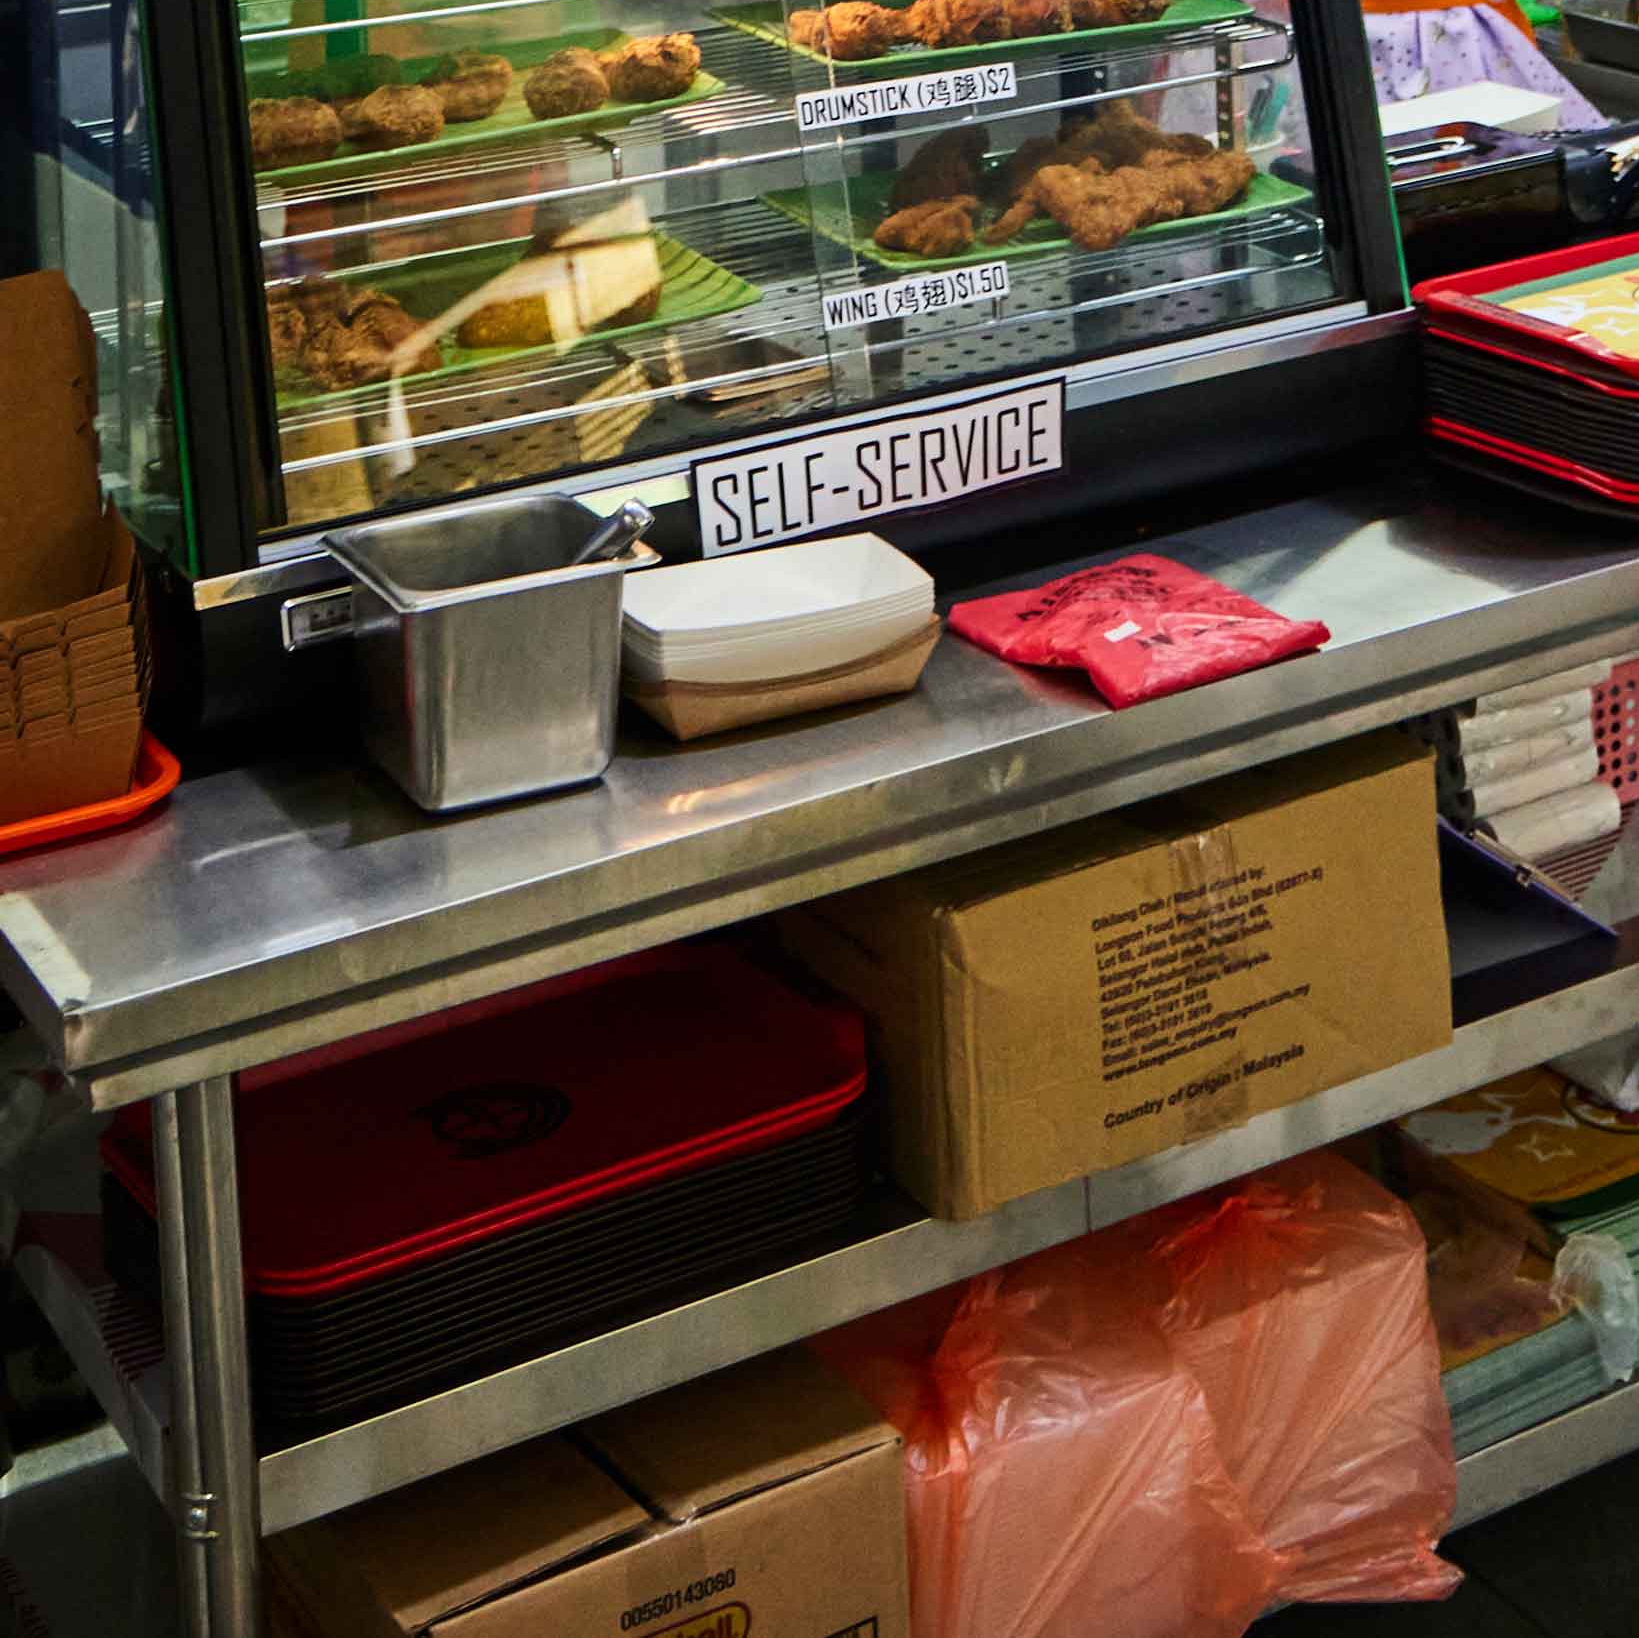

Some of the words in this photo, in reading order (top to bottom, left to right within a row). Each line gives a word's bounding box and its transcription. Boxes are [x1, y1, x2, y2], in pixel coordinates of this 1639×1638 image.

[801, 81, 912, 126] DRUMSTICK
[826, 292, 878, 325] WING
[712, 398, 1048, 548] SELF-SERVICE
[1104, 1098, 1164, 1129] Country
[1168, 1087, 1184, 1106] of
[1186, 1072, 1232, 1100] Origin
[1242, 1043, 1305, 1076] Malaysia
